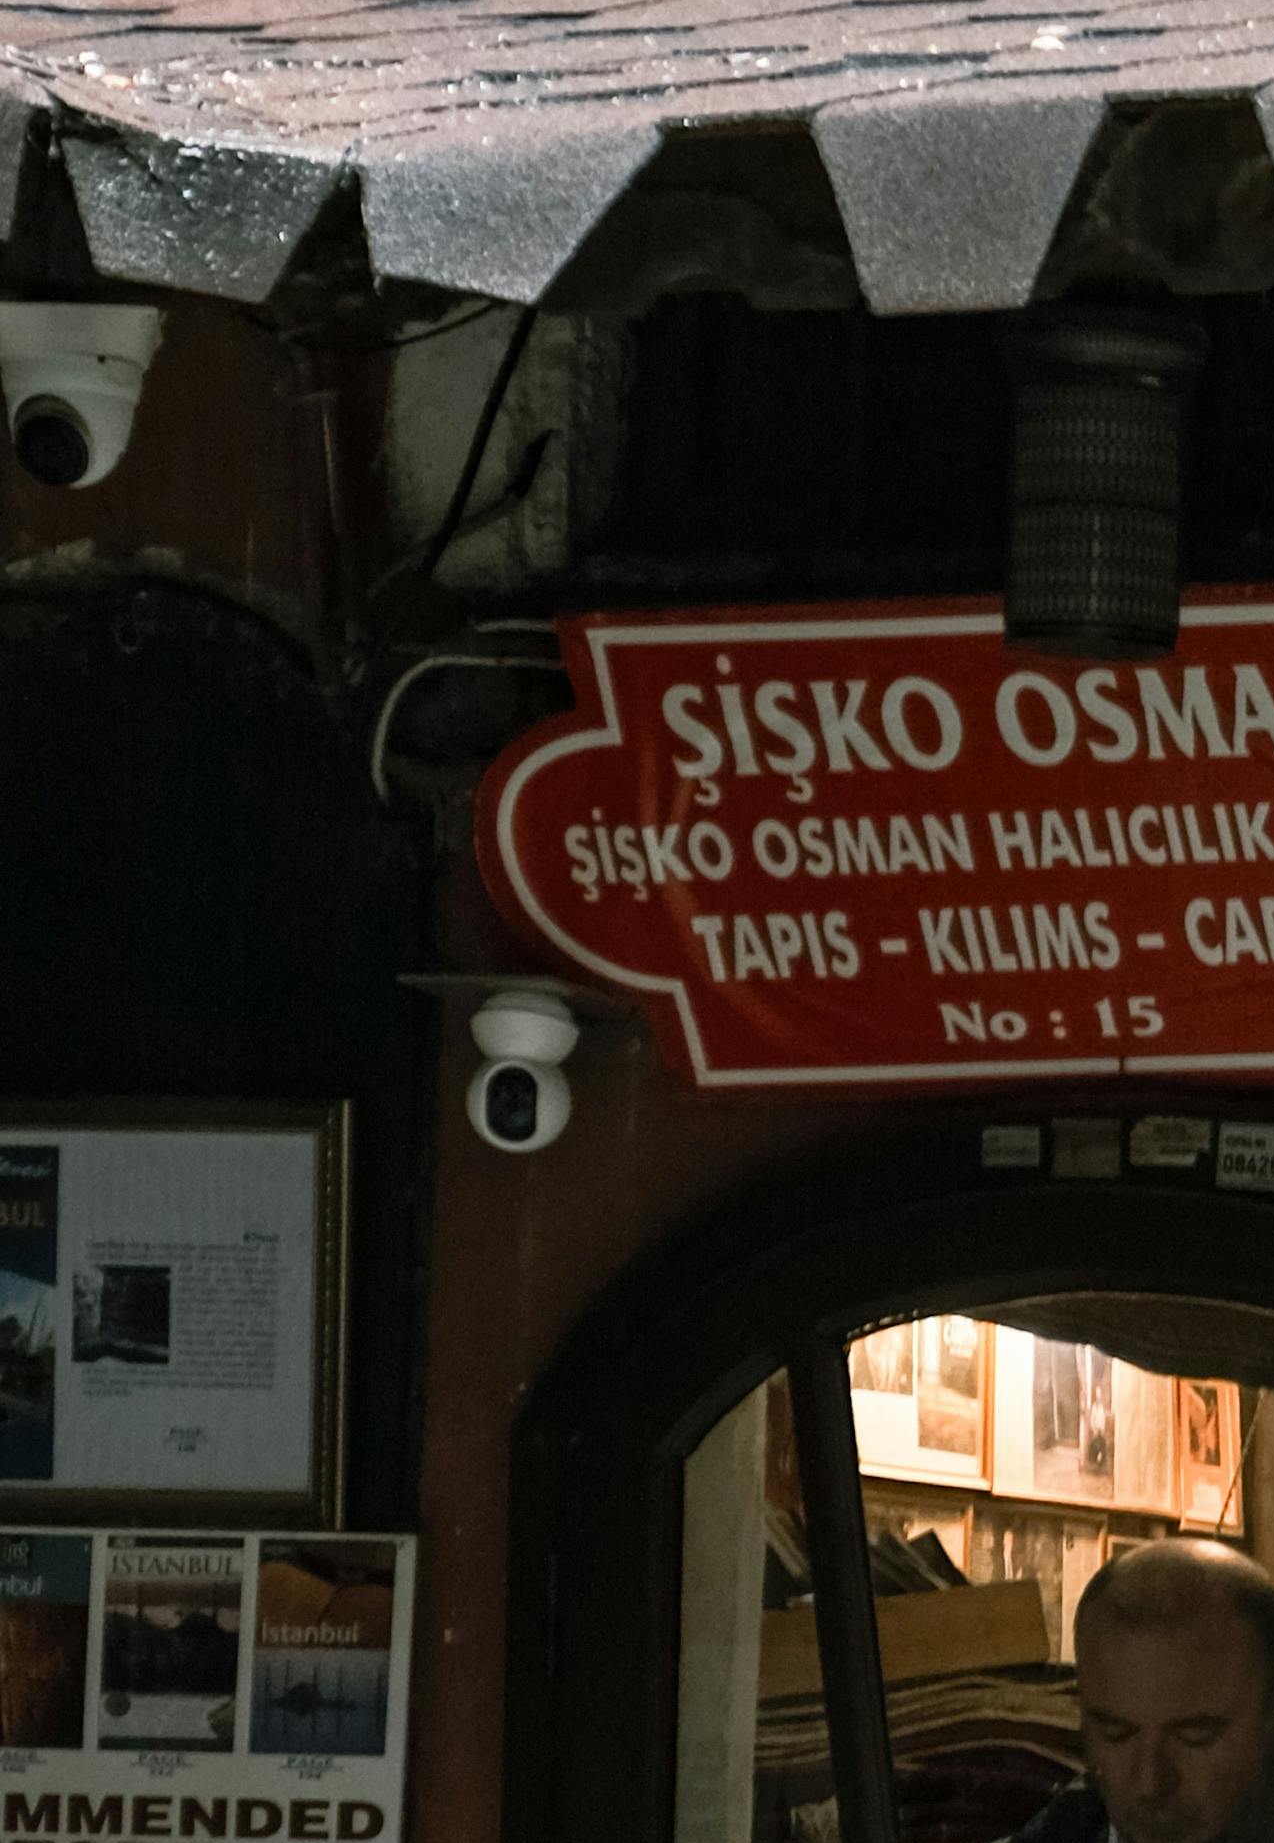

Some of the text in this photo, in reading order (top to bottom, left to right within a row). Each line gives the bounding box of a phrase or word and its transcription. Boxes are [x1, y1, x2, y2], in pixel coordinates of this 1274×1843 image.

[661, 652, 964, 807] ŞİŞKO
[563, 806, 734, 904] ŞİŞKO
[751, 812, 975, 879] OSMAN
[691, 911, 861, 983] TAPIS
[917, 901, 1121, 975] KILIMS
[938, 1001, 1028, 1044] No
[1094, 995, 1166, 1038] 15
[110, 1554, 235, 1576] ISTANBUL
[3, 1792, 384, 1841] MMENDED
